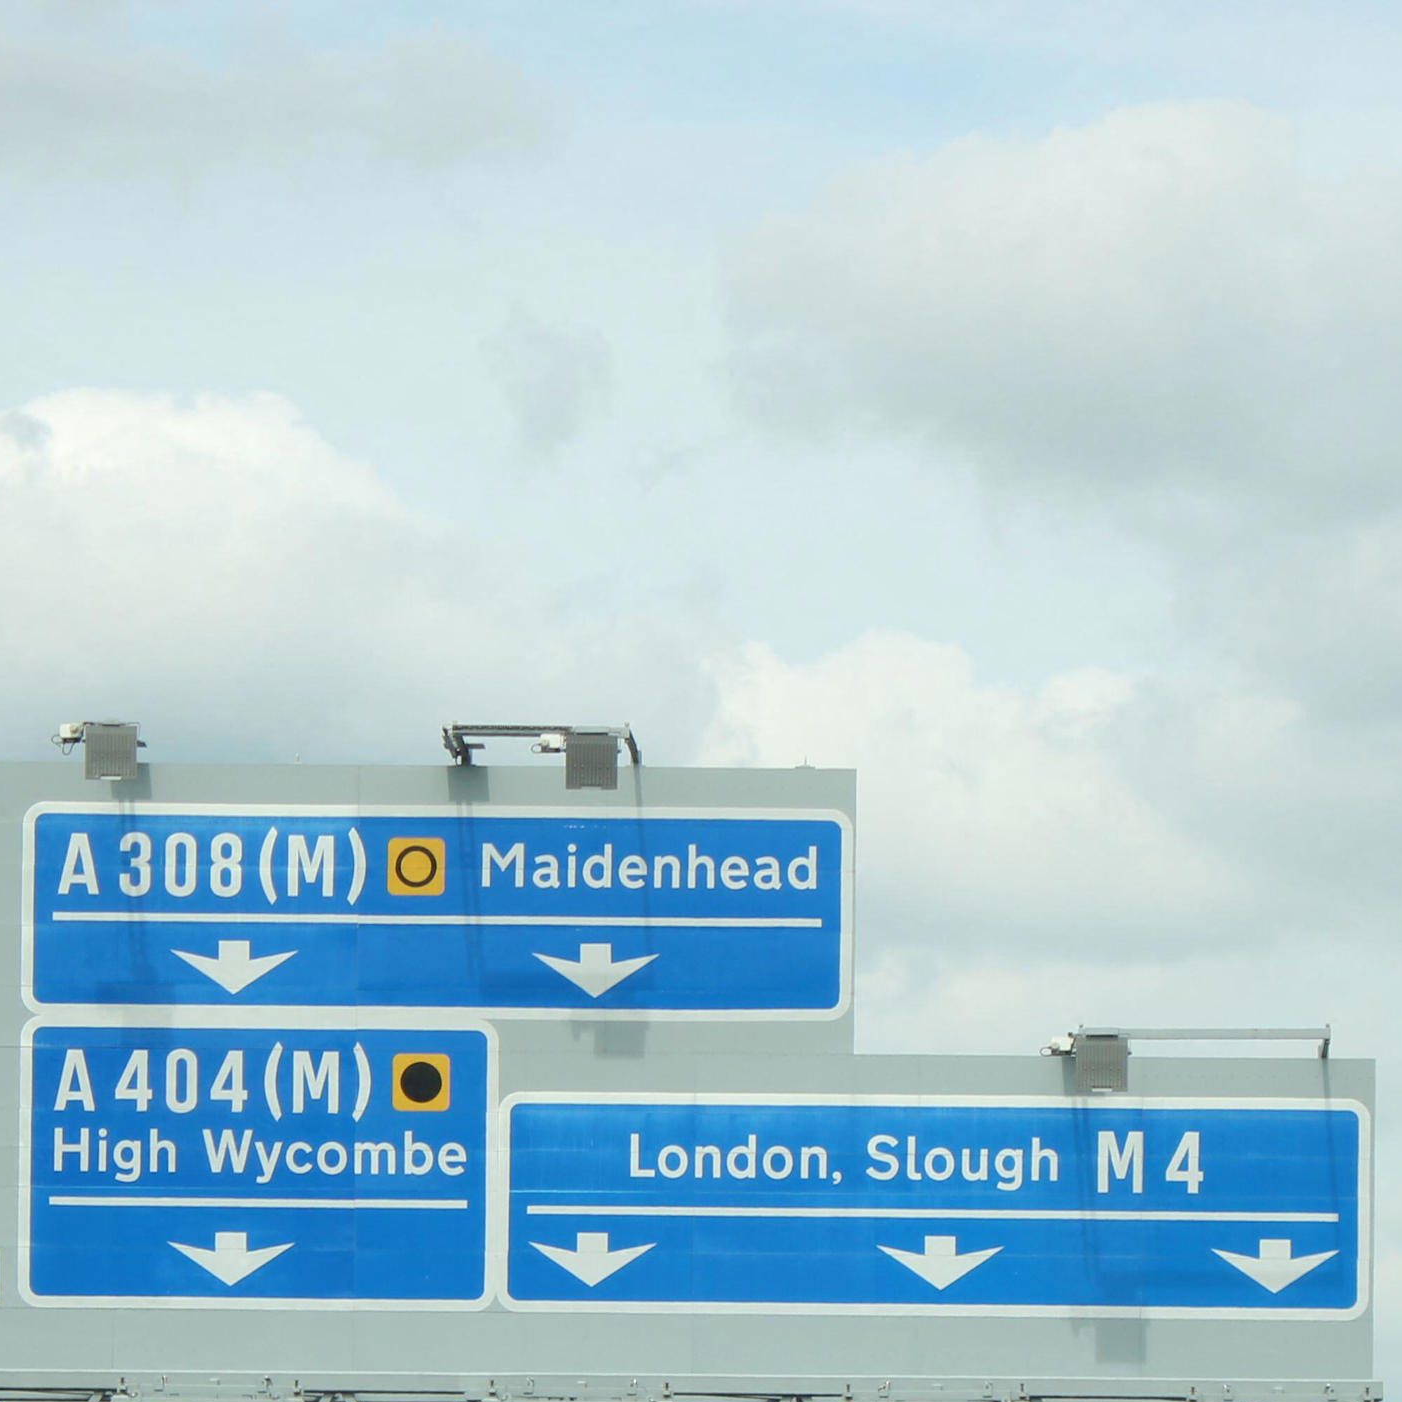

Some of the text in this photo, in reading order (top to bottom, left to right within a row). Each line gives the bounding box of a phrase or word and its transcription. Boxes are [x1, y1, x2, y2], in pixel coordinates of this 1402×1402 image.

[481, 842, 818, 891] Maidenhead
[52, 1126, 467, 1184] High Wycombe
[629, 1132, 843, 1185] London,
[865, 1134, 1059, 1191] Slough
